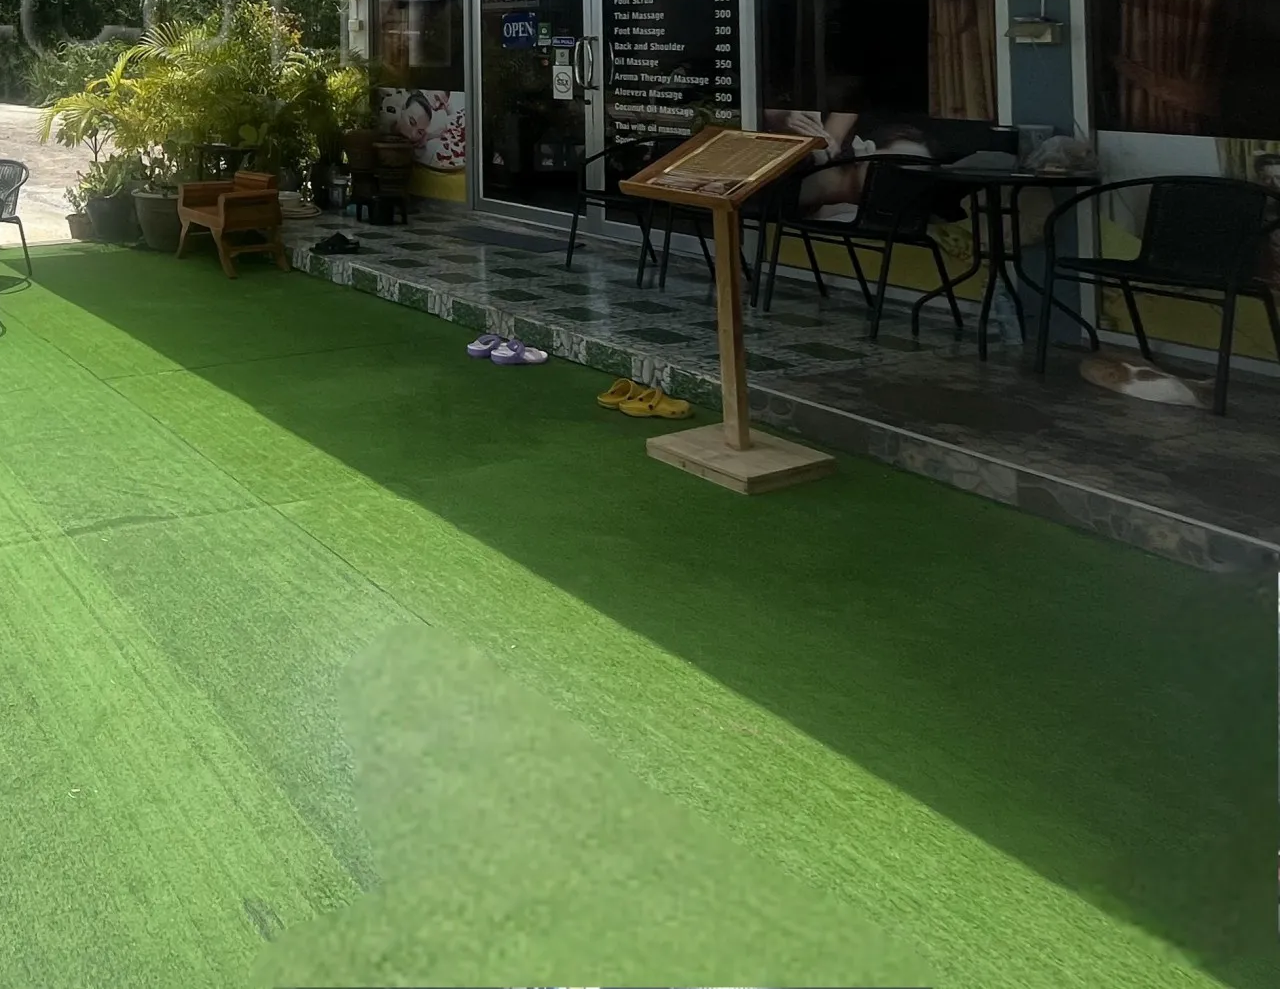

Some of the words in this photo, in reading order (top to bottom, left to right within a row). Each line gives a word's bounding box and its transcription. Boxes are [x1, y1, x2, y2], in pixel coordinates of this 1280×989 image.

[613, 11, 630, 20] Thai
[631, 11, 665, 21] Massage
[714, 9, 731, 19] 300
[503, 21, 534, 38] OPEN
[613, 27, 631, 35] Foot
[632, 27, 665, 36] Massage
[714, 26, 731, 35] 300
[614, 42, 632, 50] Back
[633, 42, 648, 51] and
[650, 42, 685, 51] Shoulder
[715, 43, 731, 52] 400
[614, 57, 625, 65] Oil
[626, 58, 659, 68] Massage
[715, 59, 732, 69] 350
[614, 72, 638, 81] Aroma
[641, 73, 671, 84] Therapy
[673, 75, 709, 85] Massage
[715, 76, 732, 85] 500
[648, 90, 683, 100] Massage
[715, 93, 732, 102] 500
[614, 102, 645, 113] Coconut
[659, 106, 694, 117] Massage
[715, 110, 732, 119] 600
[615, 121, 630, 130] Thai
[630, 123, 646, 131] with
[647, 124, 657, 132] oil
